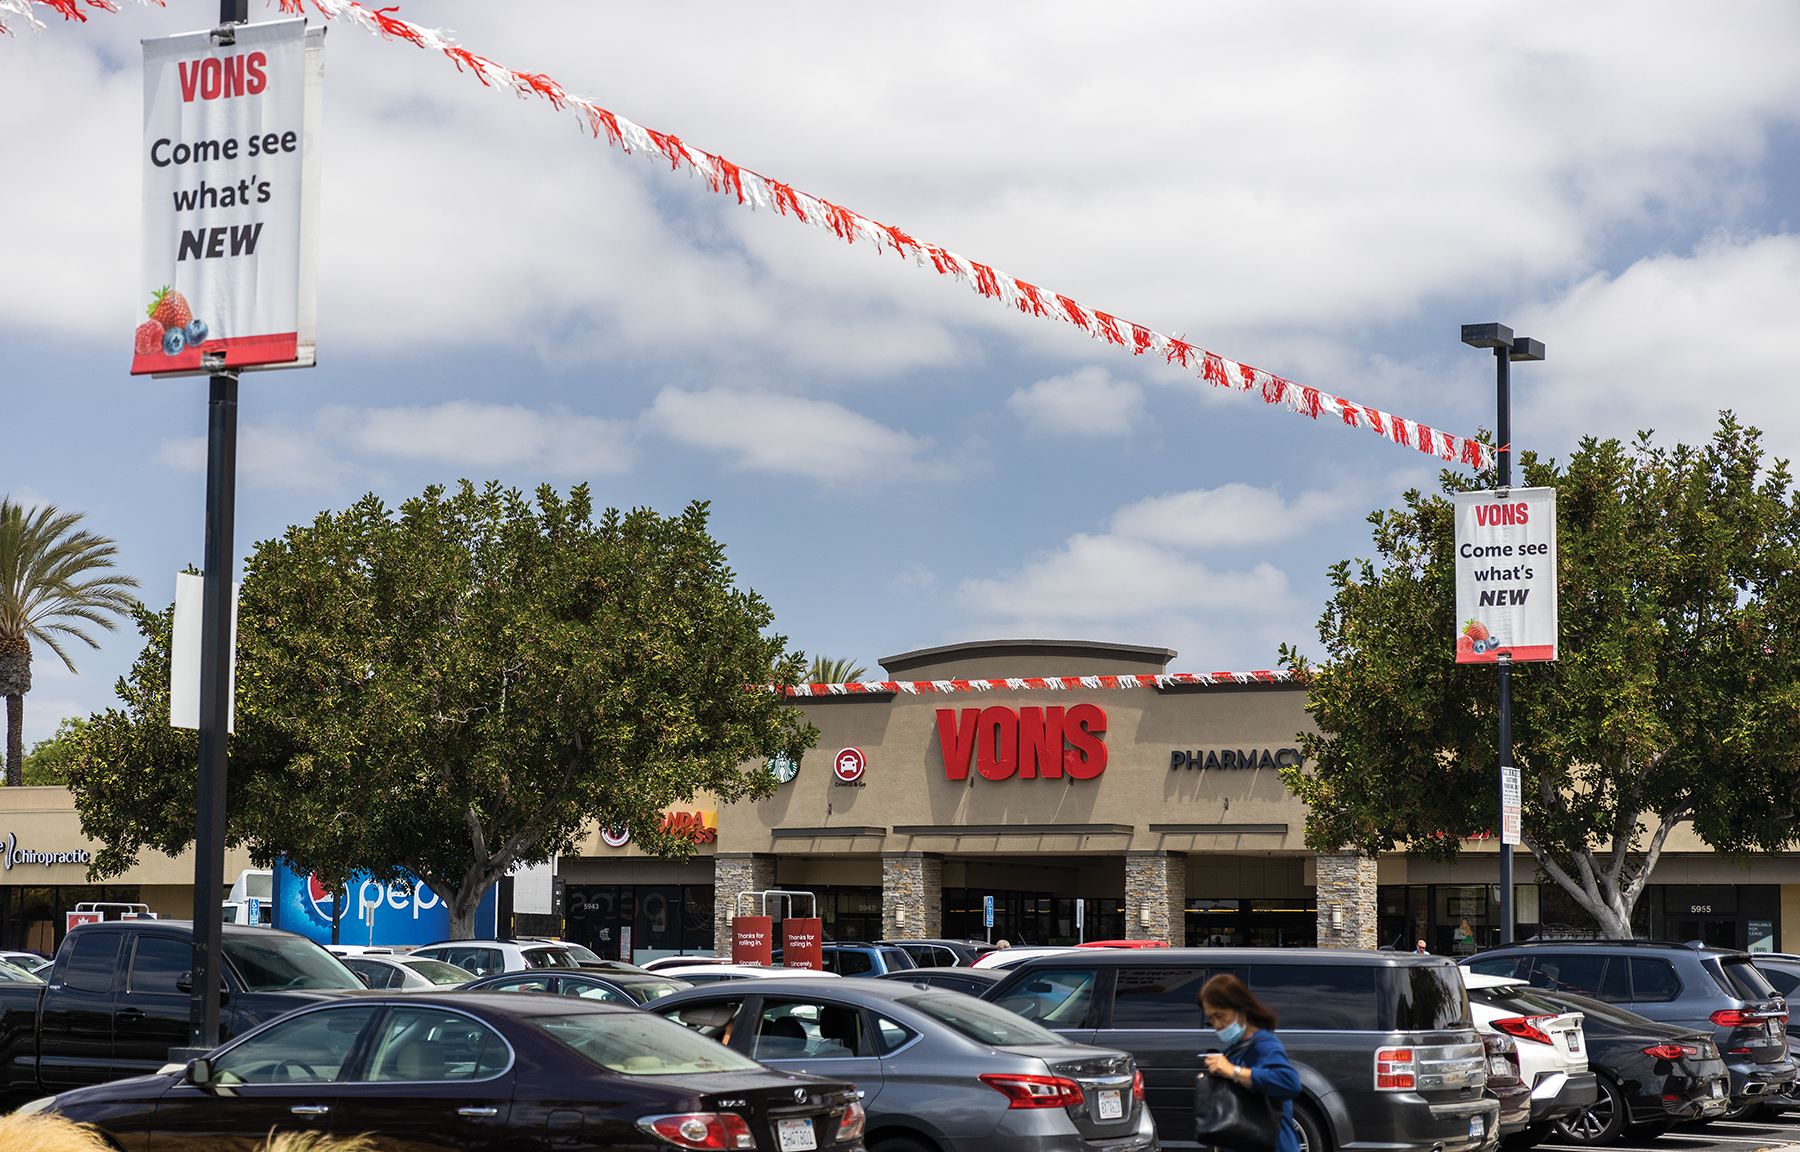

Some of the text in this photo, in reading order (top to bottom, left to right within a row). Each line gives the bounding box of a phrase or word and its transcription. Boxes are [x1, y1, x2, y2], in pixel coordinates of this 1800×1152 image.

[177, 51, 267, 103] VONS
[150, 130, 298, 168] Come see
[173, 174, 271, 212] what's
[177, 222, 264, 262] NEW
[1475, 502, 1529, 526] VONS
[1460, 542, 1548, 559] Come see
[1474, 564, 1534, 581] what's
[1479, 588, 1530, 607] NEW
[935, 703, 1108, 781] VONS
[1171, 748, 1303, 770] PHARMACY
[12, 849, 90, 867] Chiropractic
[358, 877, 448, 920] pep
[583, 902, 600, 910] 5943
[858, 904, 877, 912] 5945
[1690, 905, 1712, 913] 5955
[739, 939, 755, 947] rolling
[789, 940, 806, 948] rolling
